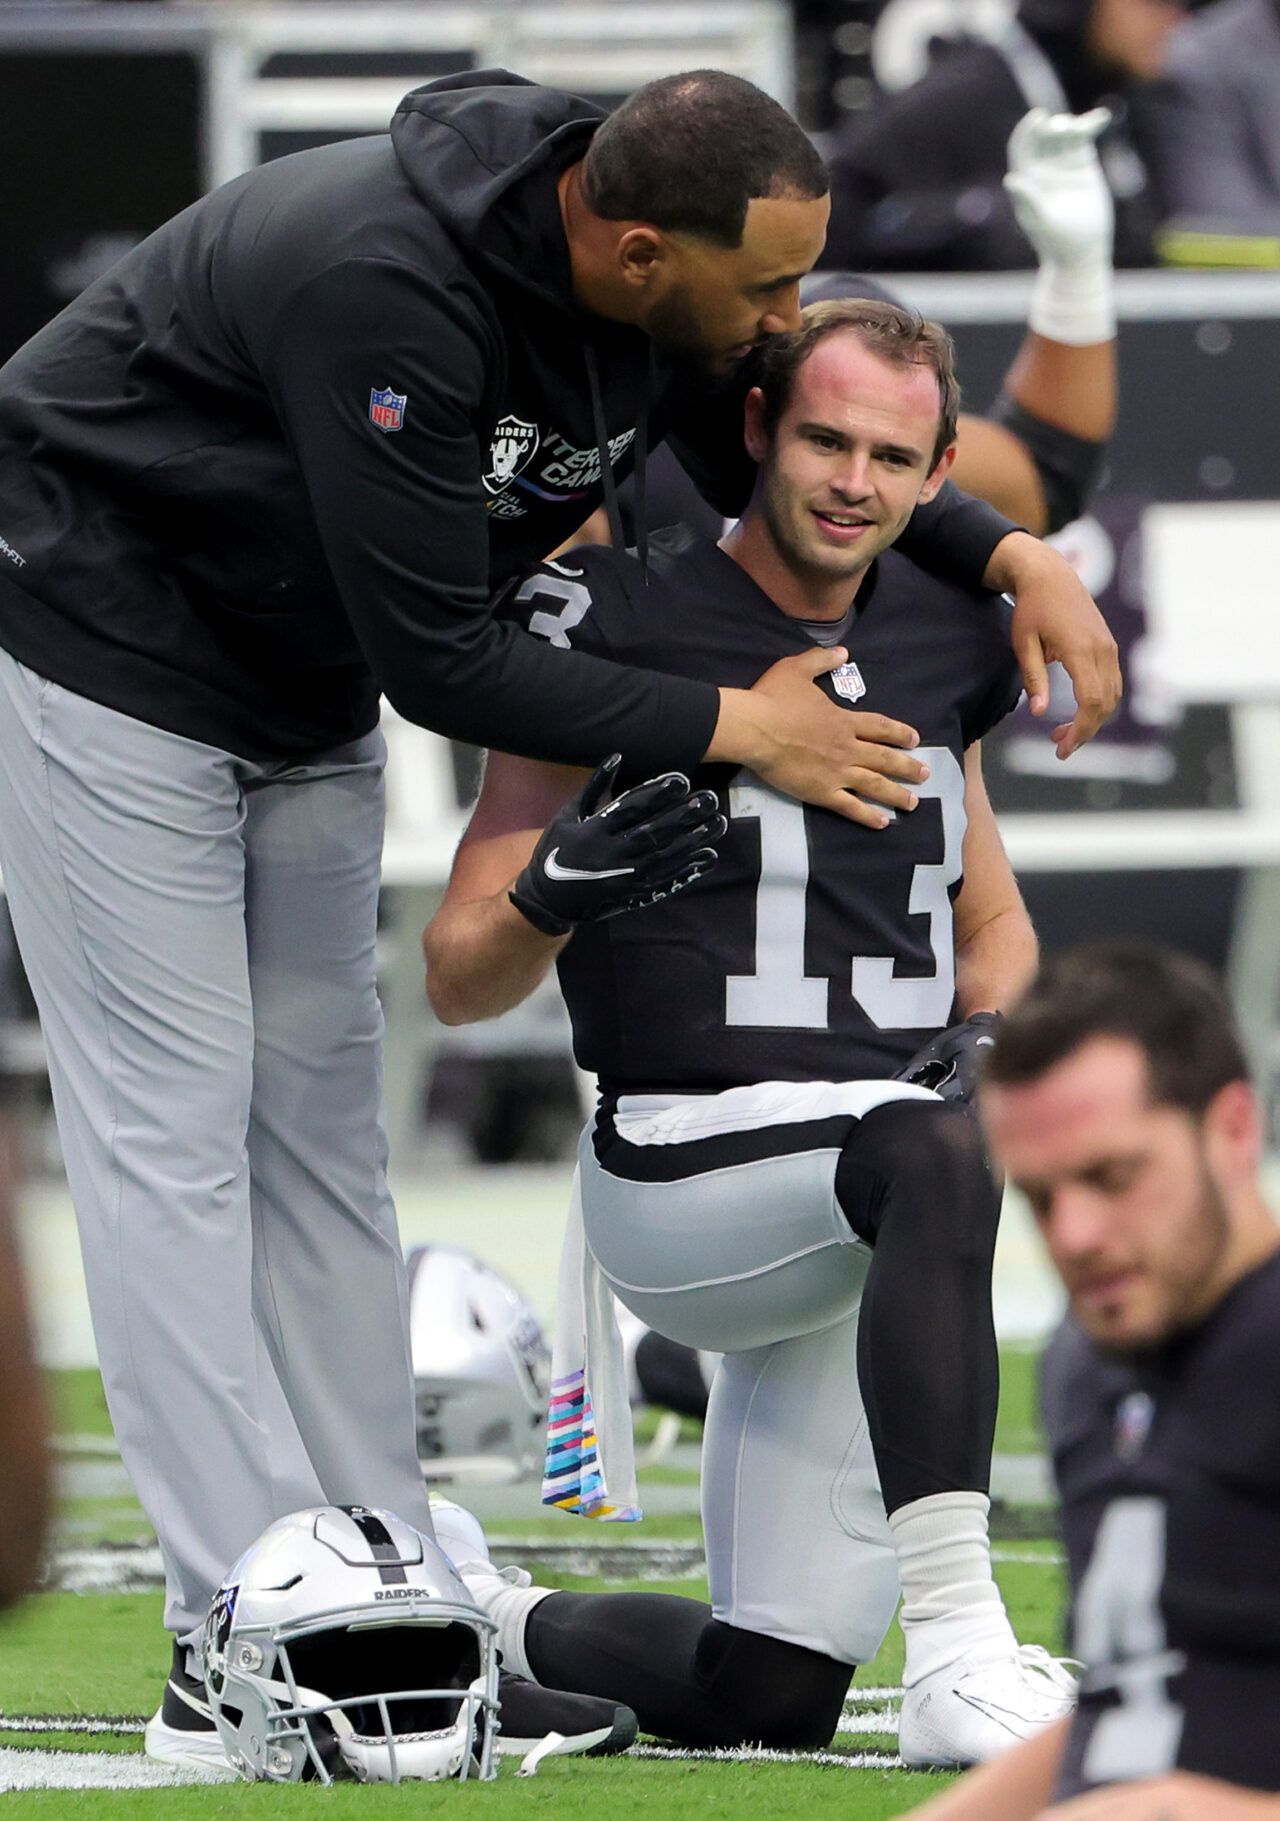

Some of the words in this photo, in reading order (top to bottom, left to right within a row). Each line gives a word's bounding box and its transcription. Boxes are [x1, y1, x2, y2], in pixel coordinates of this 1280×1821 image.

[494, 426, 534, 438] AIDERS
[725, 744, 969, 1029] 13
[374, 1587, 431, 1601] RAIDERS
